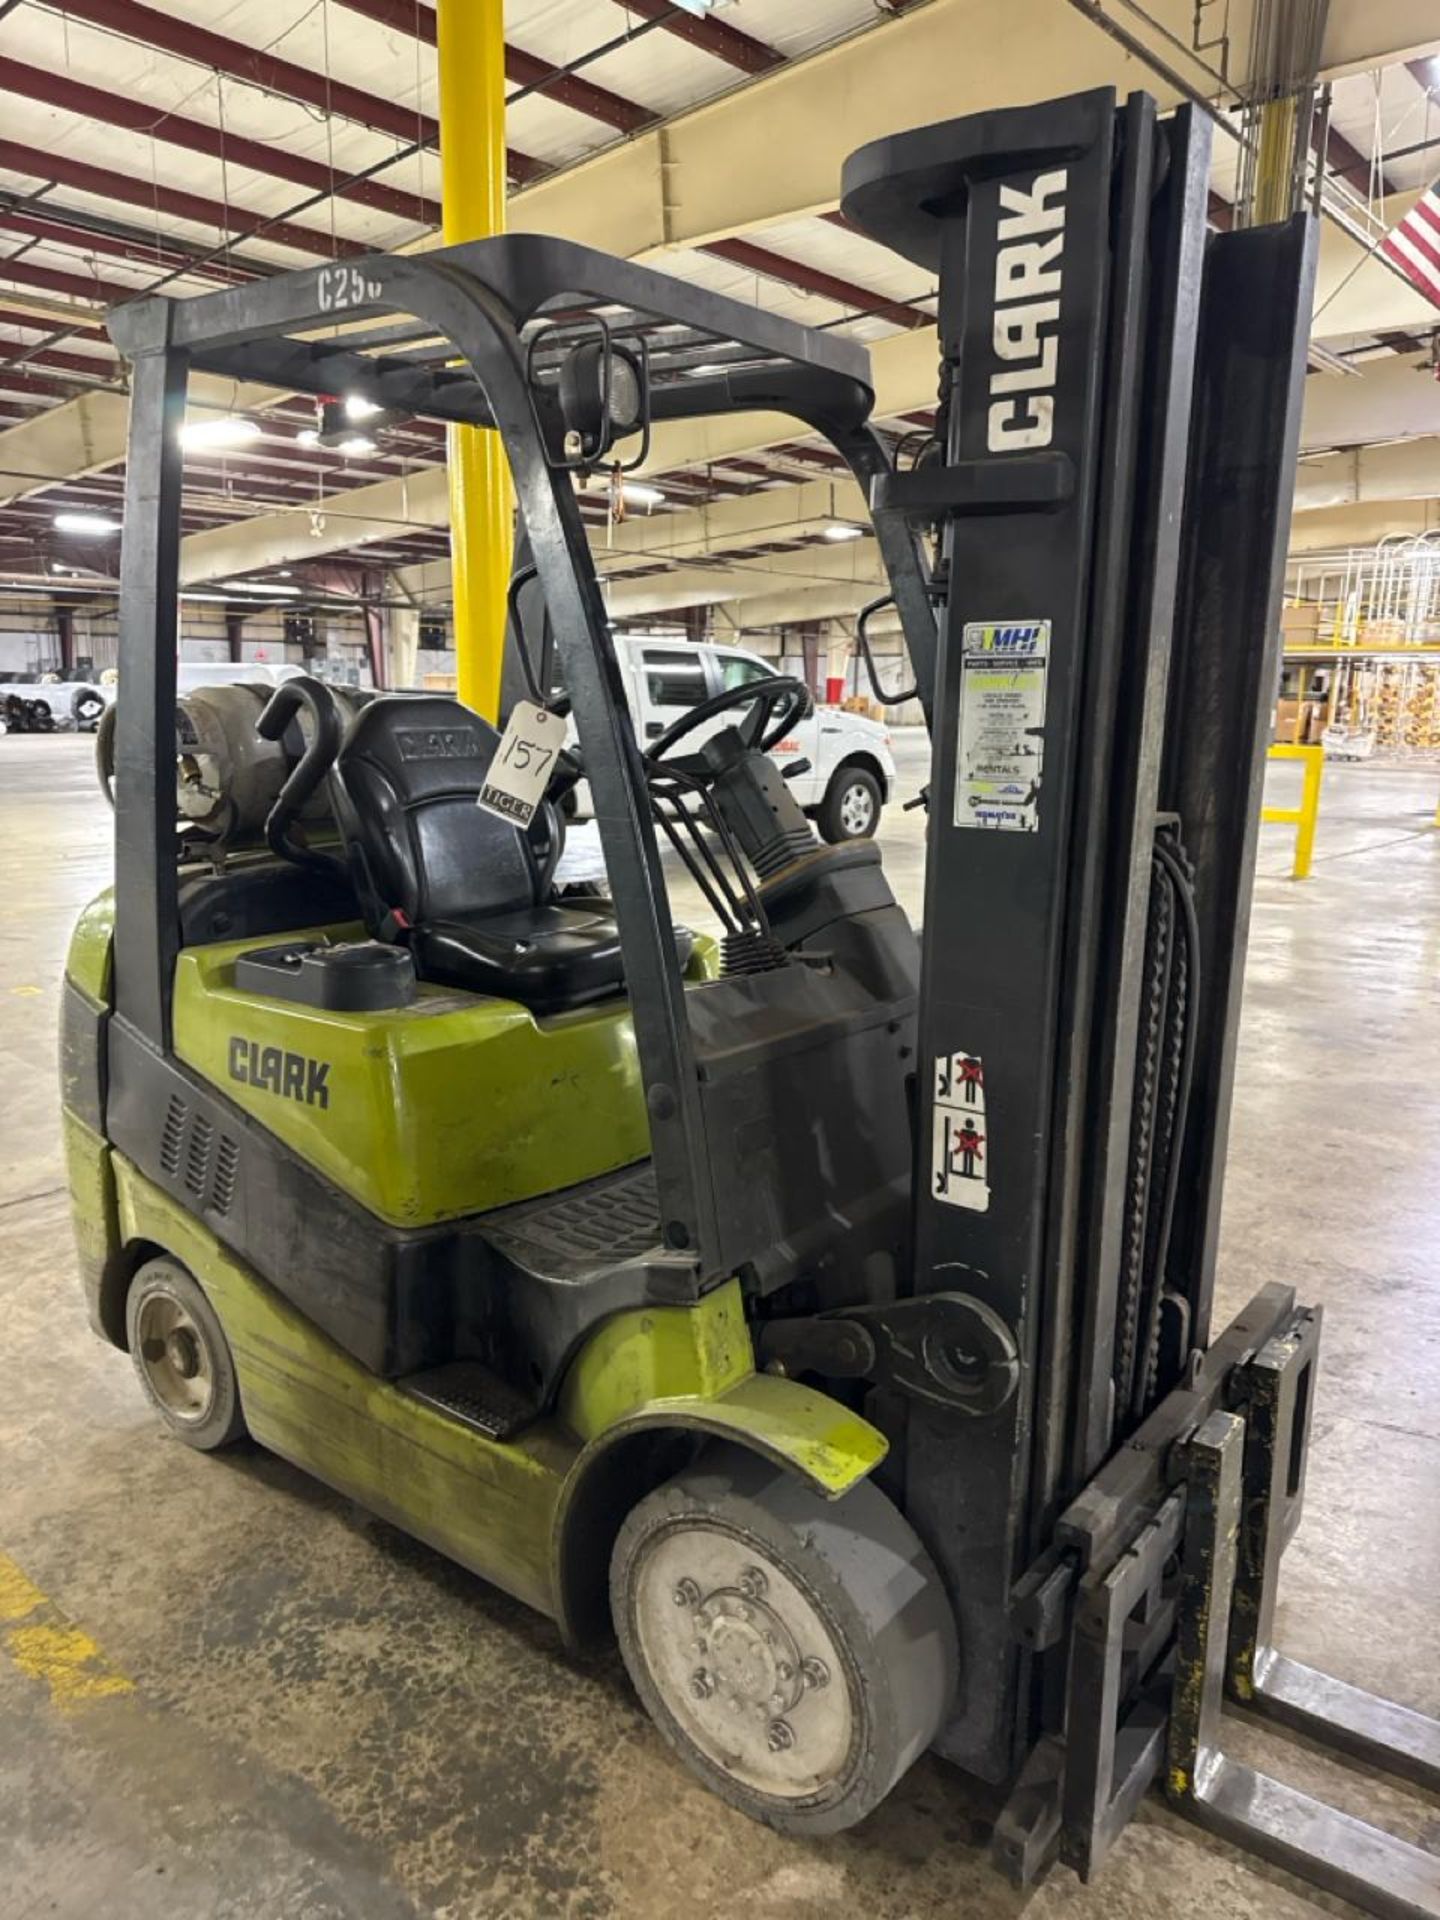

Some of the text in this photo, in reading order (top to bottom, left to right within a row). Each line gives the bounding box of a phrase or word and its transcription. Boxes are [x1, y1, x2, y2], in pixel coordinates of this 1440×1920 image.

[987, 168, 1067, 452] CLARK
[502, 735, 553, 777] 157
[485, 787, 531, 819] TIGER
[229, 1036, 331, 1110] CLARK
